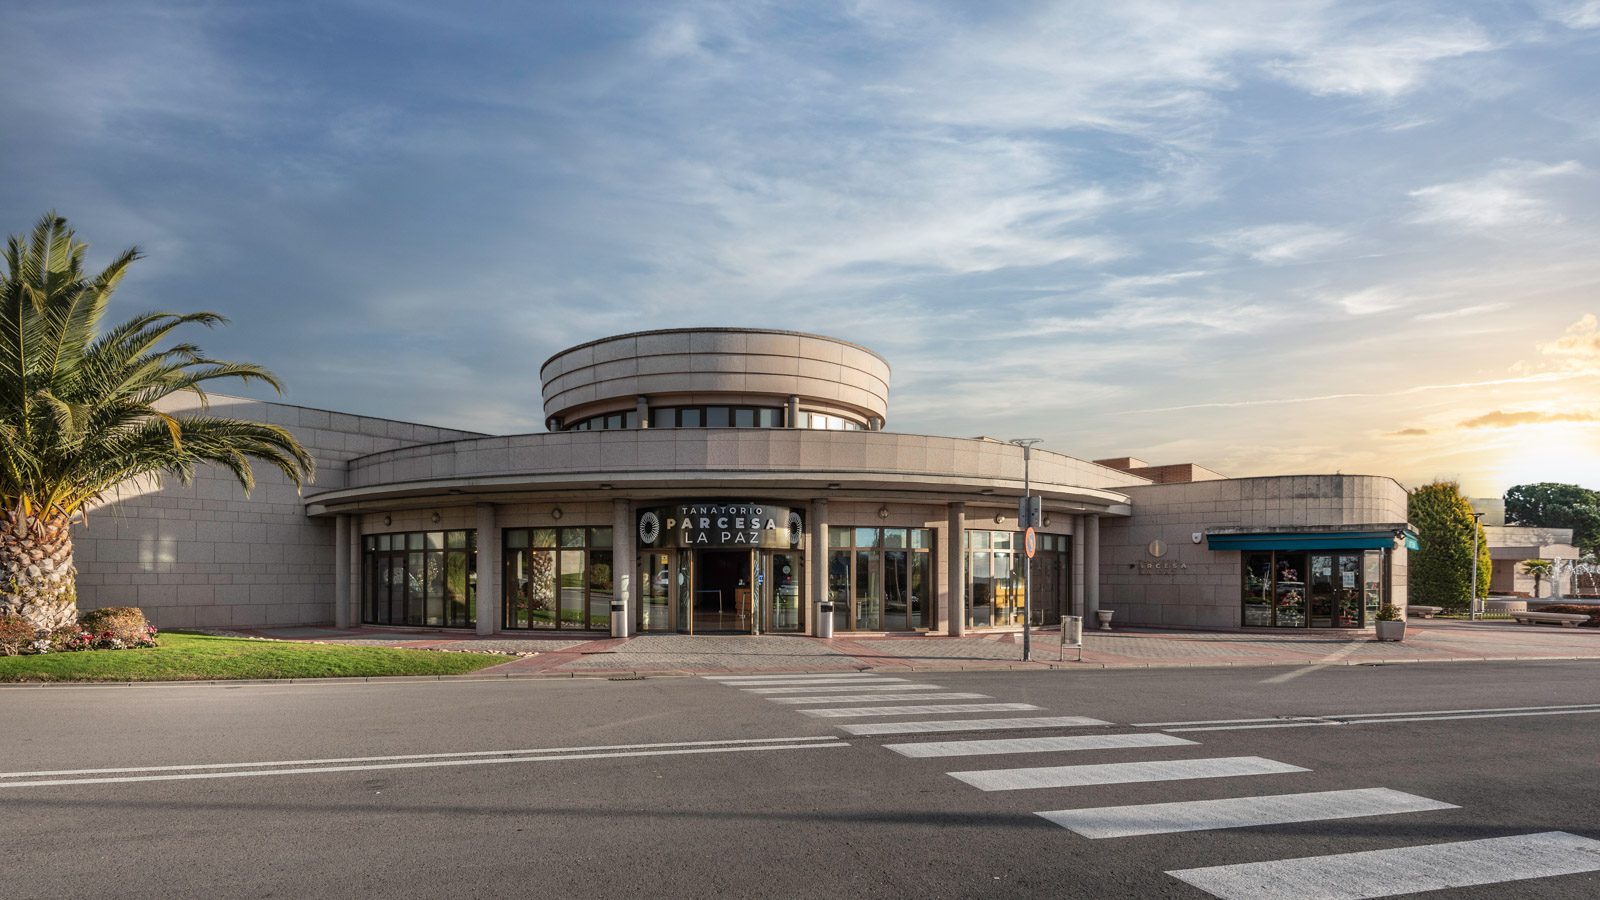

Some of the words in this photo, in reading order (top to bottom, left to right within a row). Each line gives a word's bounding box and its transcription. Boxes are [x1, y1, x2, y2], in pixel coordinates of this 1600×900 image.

[682, 507, 763, 515] TANATORIO
[666, 517, 776, 530] PARCESA
[685, 532, 708, 543] LA
[721, 532, 759, 543] PAZ
